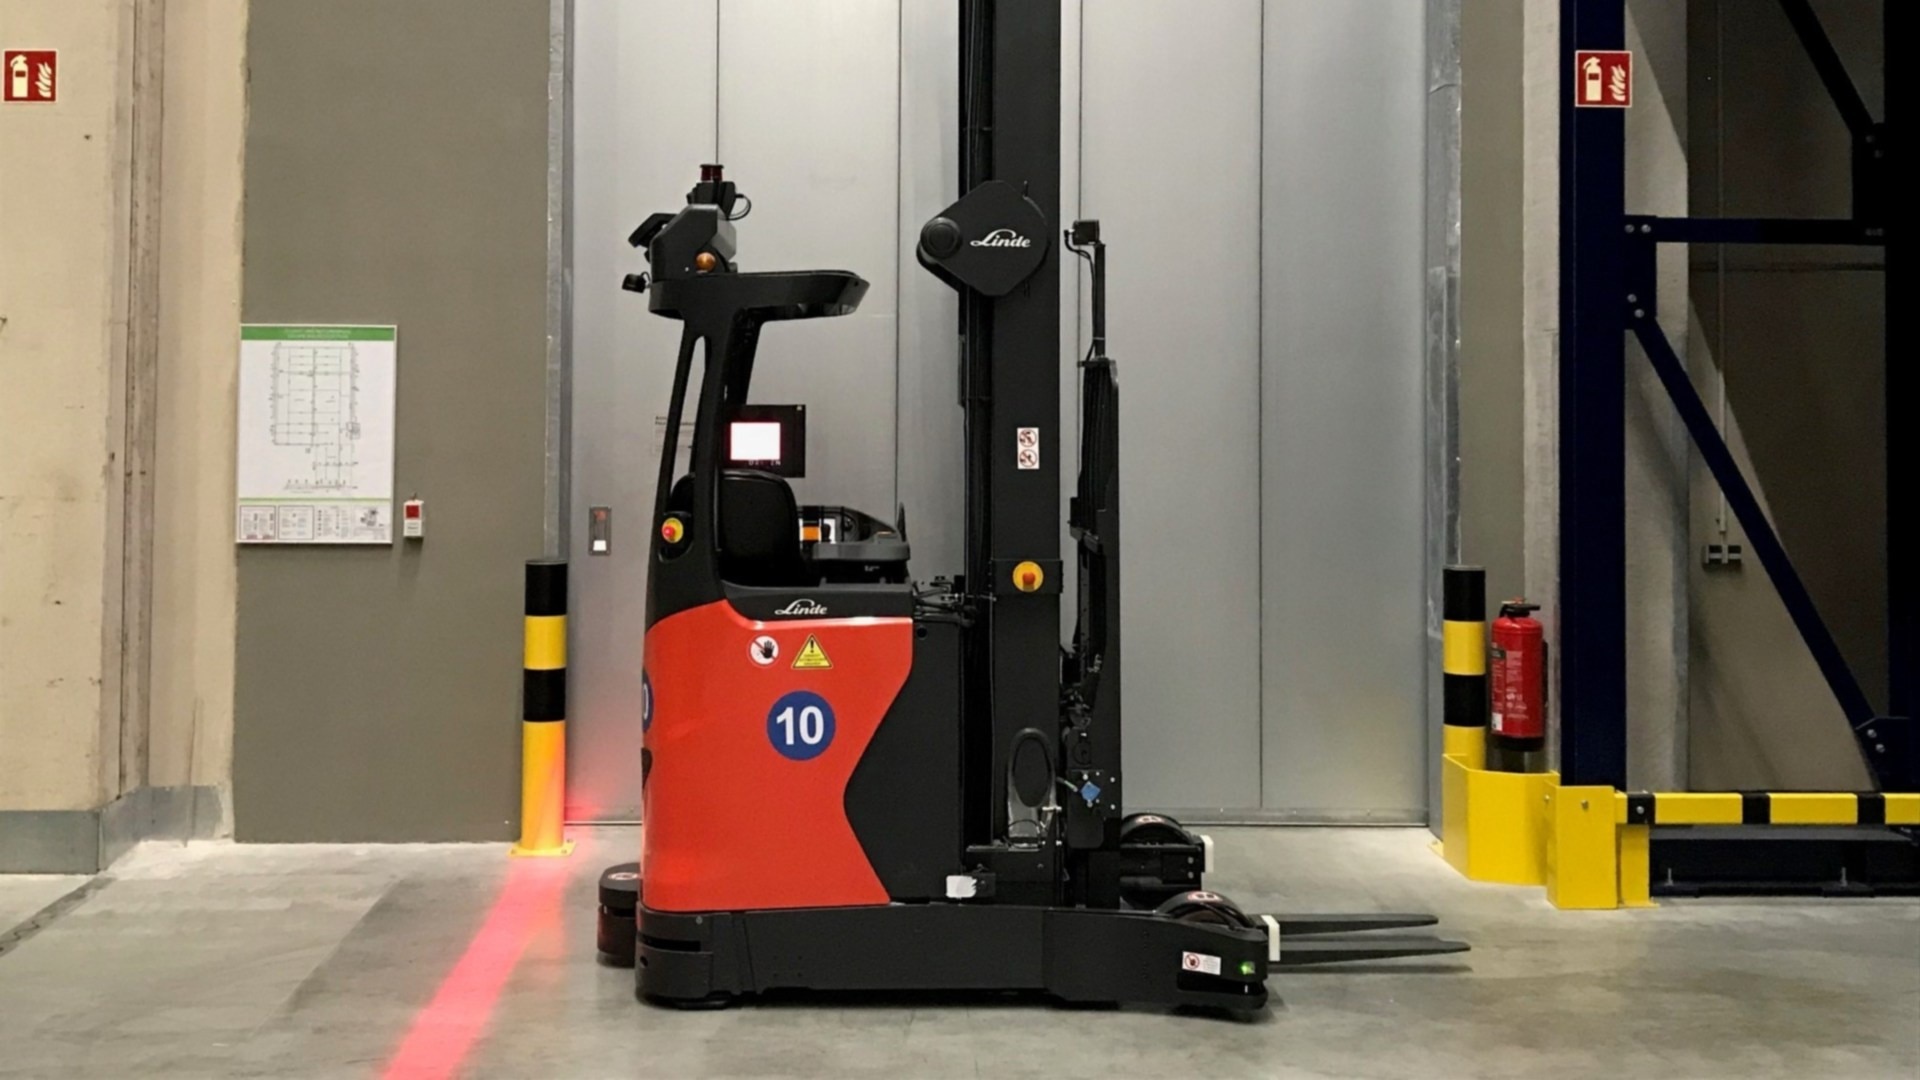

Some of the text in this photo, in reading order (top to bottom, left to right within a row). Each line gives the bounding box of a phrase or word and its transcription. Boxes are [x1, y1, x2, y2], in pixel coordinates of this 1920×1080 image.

[969, 228, 1031, 248] Linde
[774, 598, 827, 615] Linde
[776, 705, 824, 745] 10
